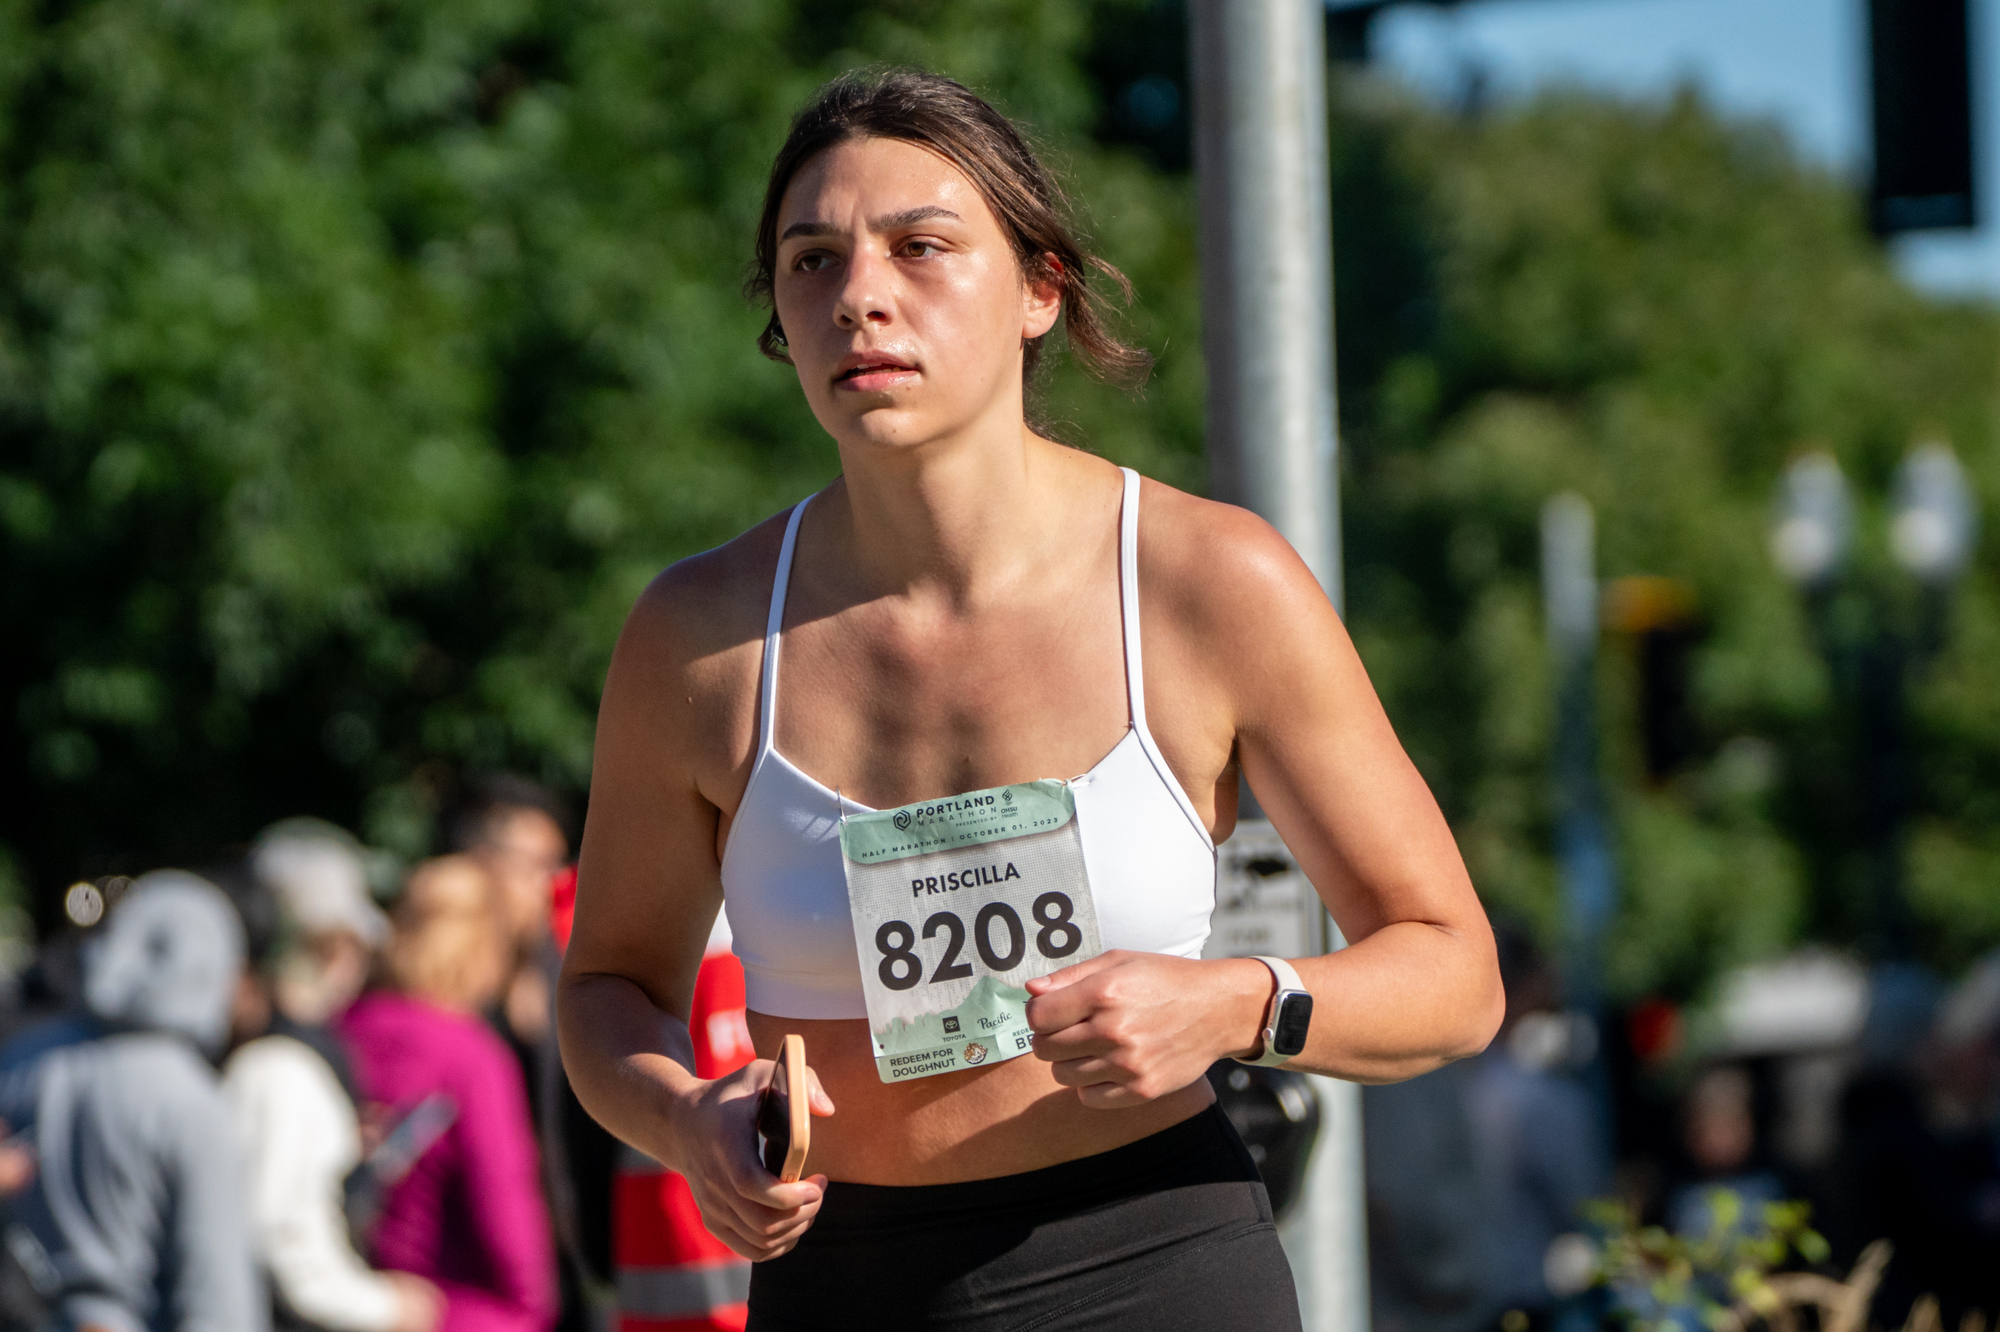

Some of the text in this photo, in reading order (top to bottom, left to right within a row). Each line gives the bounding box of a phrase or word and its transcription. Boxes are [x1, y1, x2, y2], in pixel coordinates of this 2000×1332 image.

[916, 795, 995, 818] PORTLAND
[1000, 806, 1018, 814] OHSU
[918, 806, 997, 827] MARATHON
[955, 817, 989, 827] PRESENTED
[862, 848, 887, 859] HALF
[892, 837, 946, 853] MARATHON
[959, 826, 1006, 841] OCTOBER
[1032, 817, 1060, 827] 2023
[911, 862, 1021, 897] PRISCILLA
[875, 891, 1083, 991] 8208
[976, 1011, 1013, 1030] Pacific
[942, 1033, 966, 1043] TOYOTA
[1012, 1027, 1029, 1037] REDE
[890, 1048, 954, 1067] REDEEM FOR
[892, 1057, 956, 1077] DOUGHNUT
